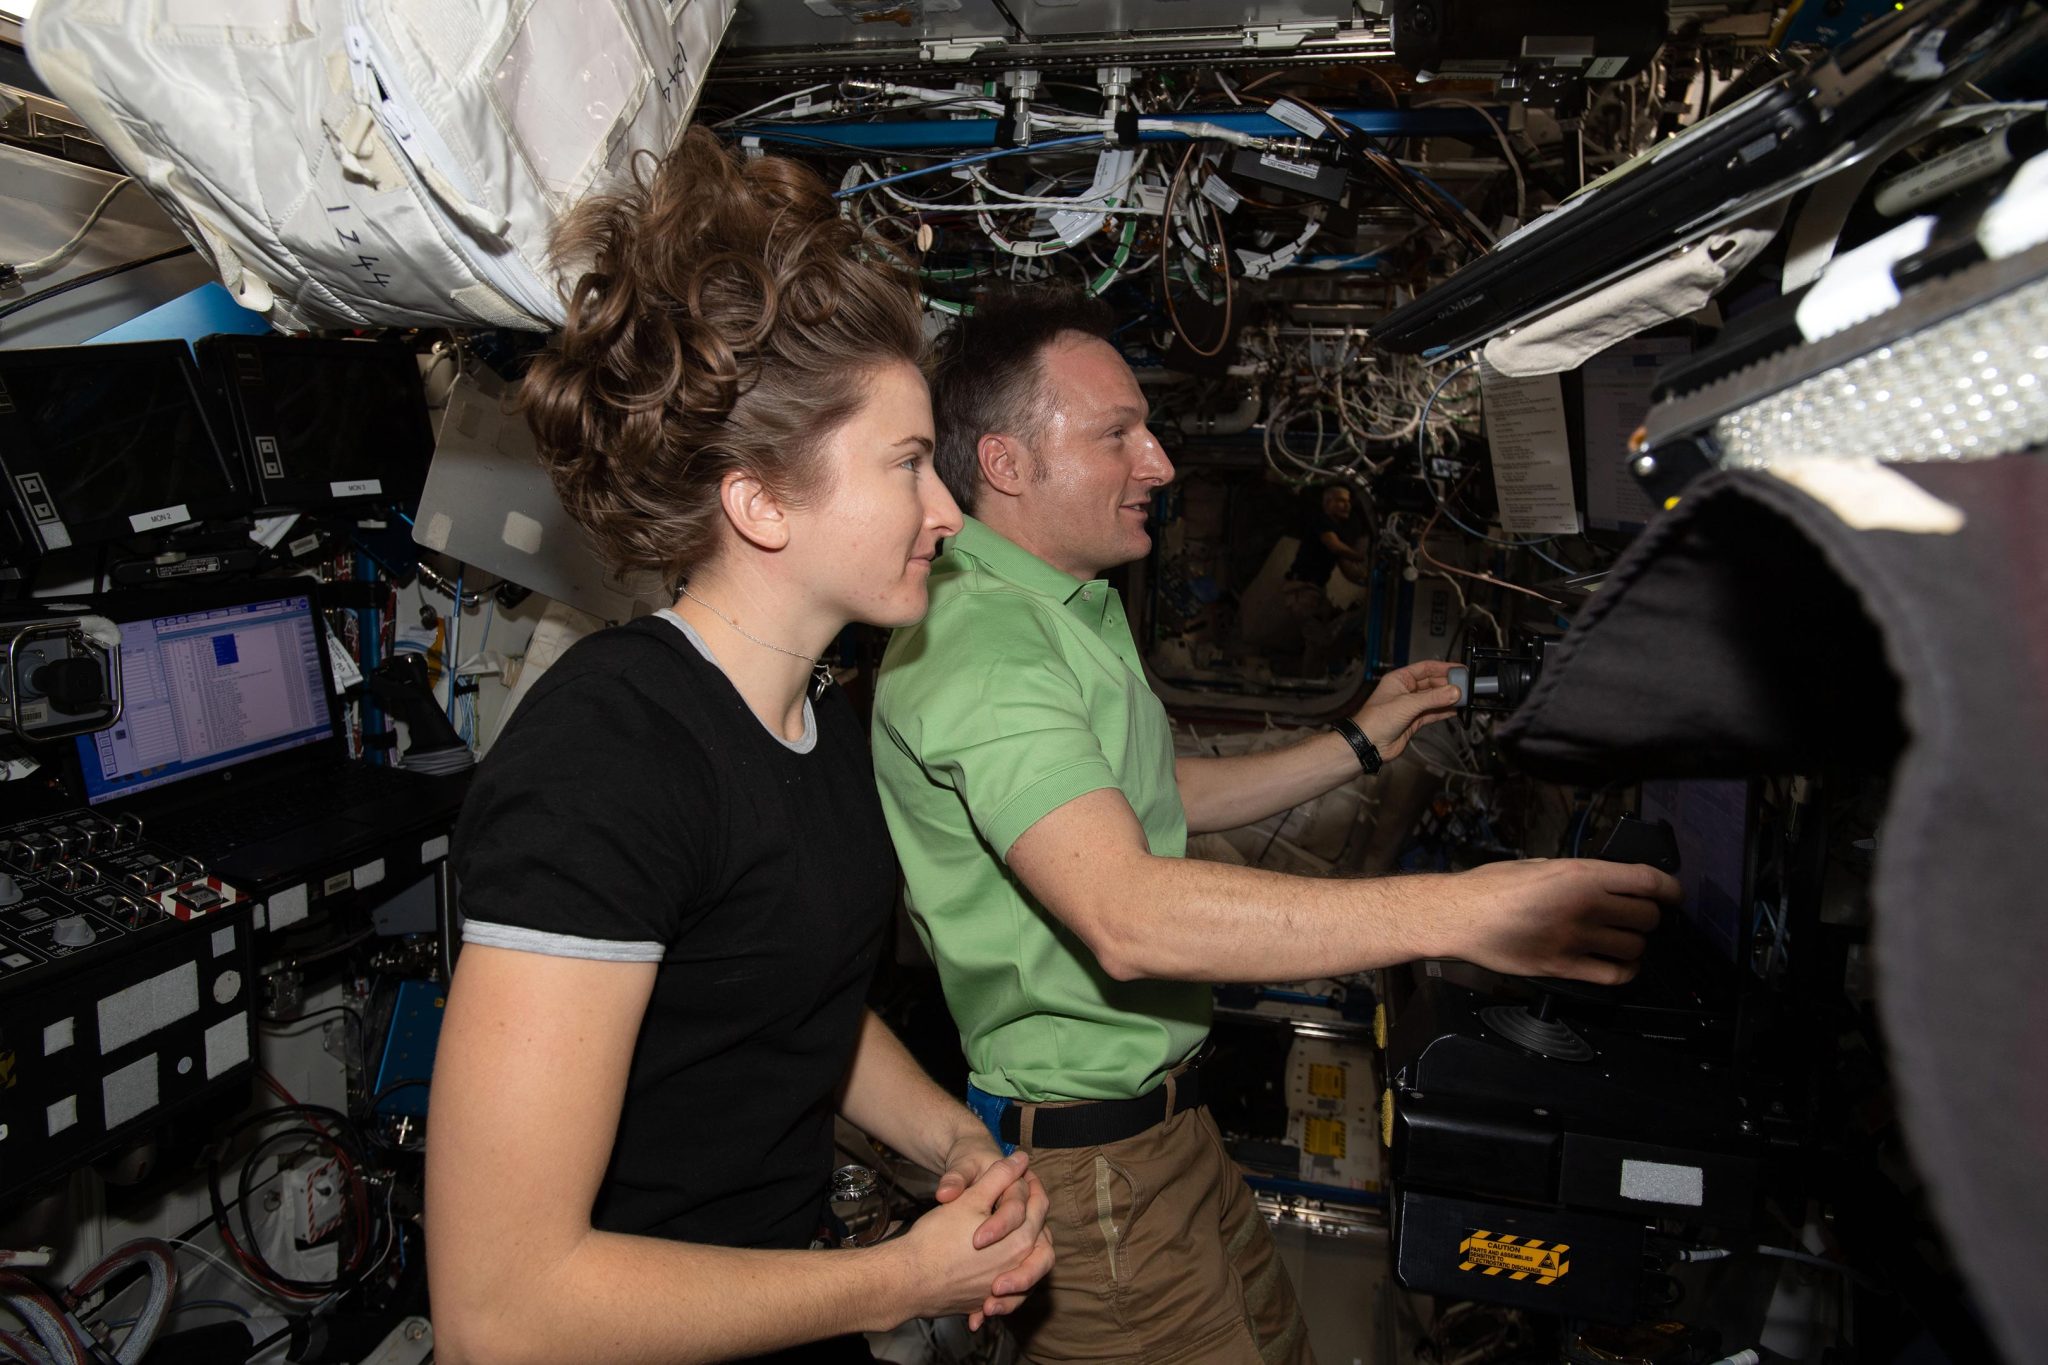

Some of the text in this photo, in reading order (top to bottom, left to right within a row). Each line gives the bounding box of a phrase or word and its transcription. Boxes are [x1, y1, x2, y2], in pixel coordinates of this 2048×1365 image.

[658, 41, 687, 103] 1244
[327, 205, 391, 288] 1244
[348, 484, 361, 492] MON
[151, 512, 172, 523] MON 2
[1470, 1246, 1487, 1254] PARTS
[1500, 1251, 1533, 1262] ASSEMBLIES
[1487, 1242, 1521, 1253] CAUTION
[1470, 1252, 1496, 1260] SENSITIVE
[1469, 1256, 1542, 1274] ELECTROSTATIC DISCHARGE
